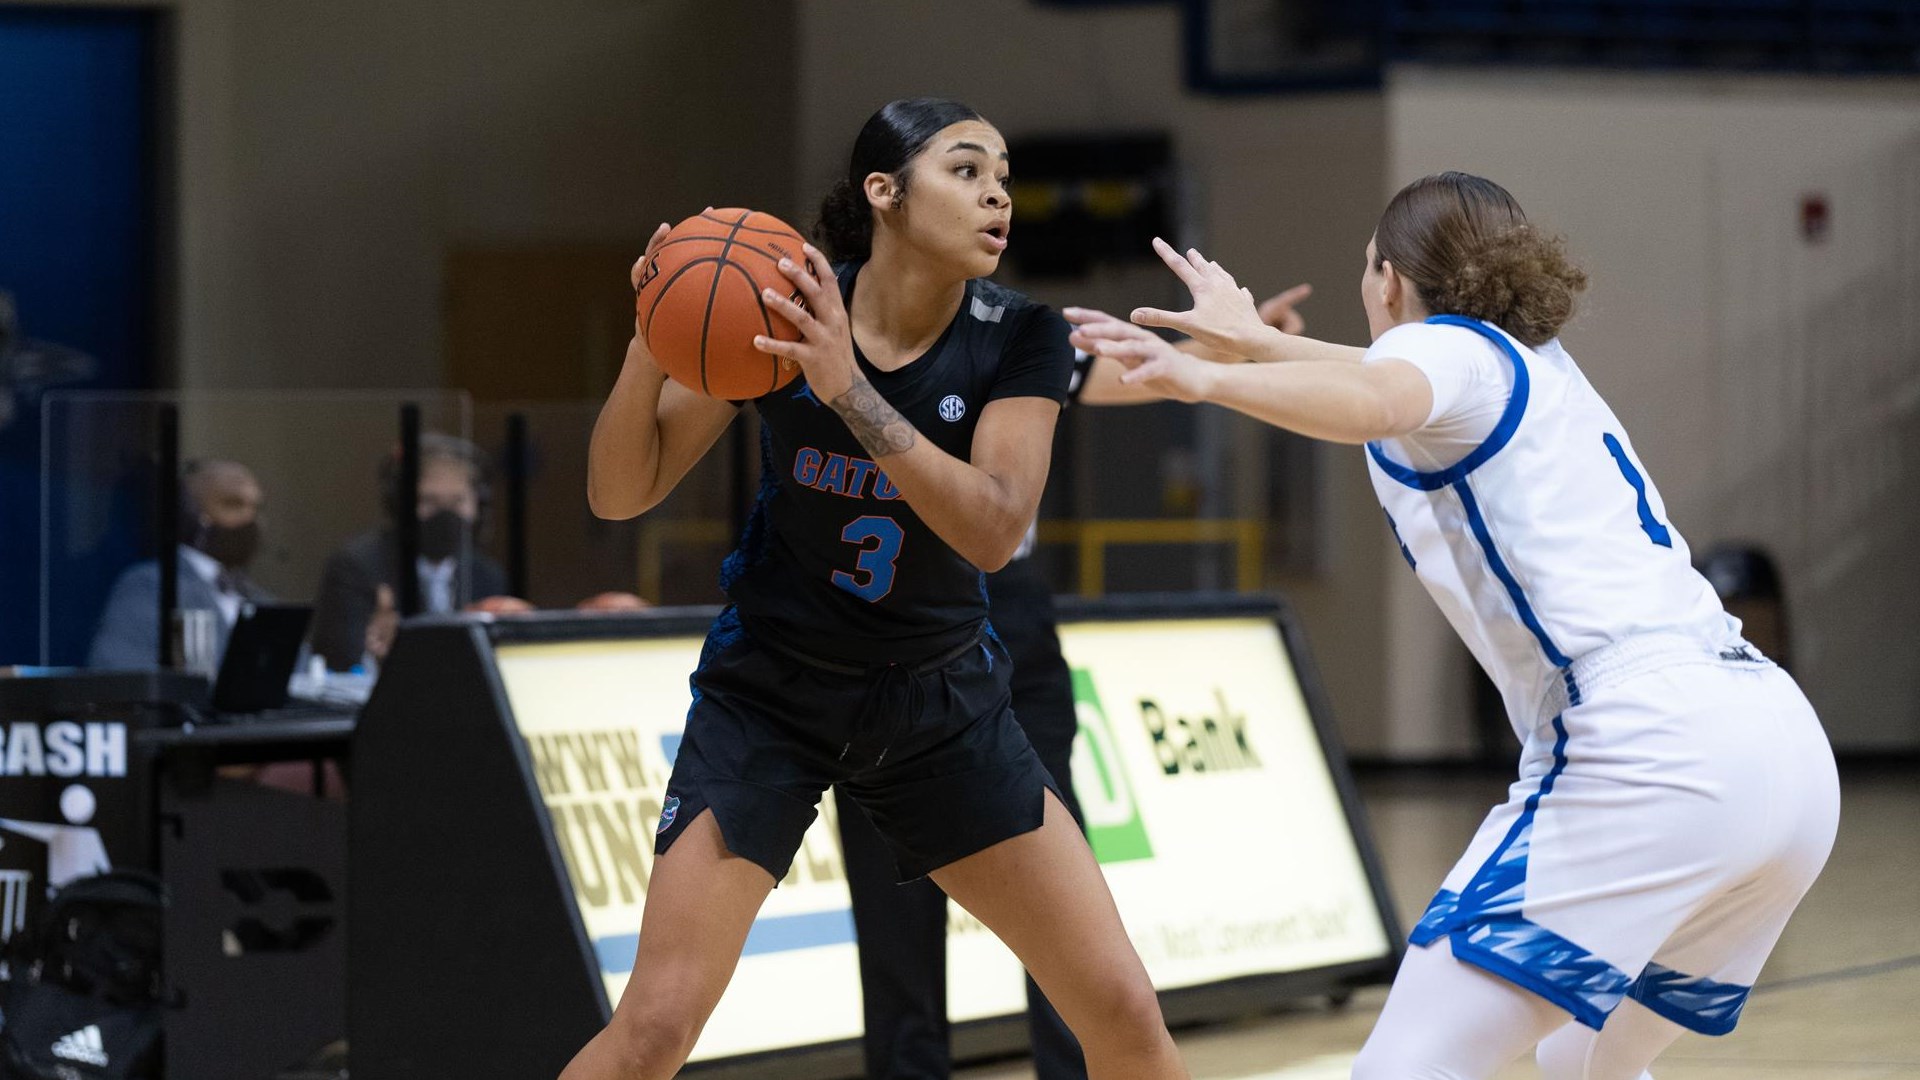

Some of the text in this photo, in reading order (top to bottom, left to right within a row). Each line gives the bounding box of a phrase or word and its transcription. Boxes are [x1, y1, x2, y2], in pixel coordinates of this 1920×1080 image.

[941, 396, 964, 421] SEC
[793, 447, 905, 500] GATO
[1602, 432, 1672, 549] 1
[831, 515, 905, 603] 3
[0, 721, 128, 778] ASH
[1137, 687, 1264, 776] Bank
